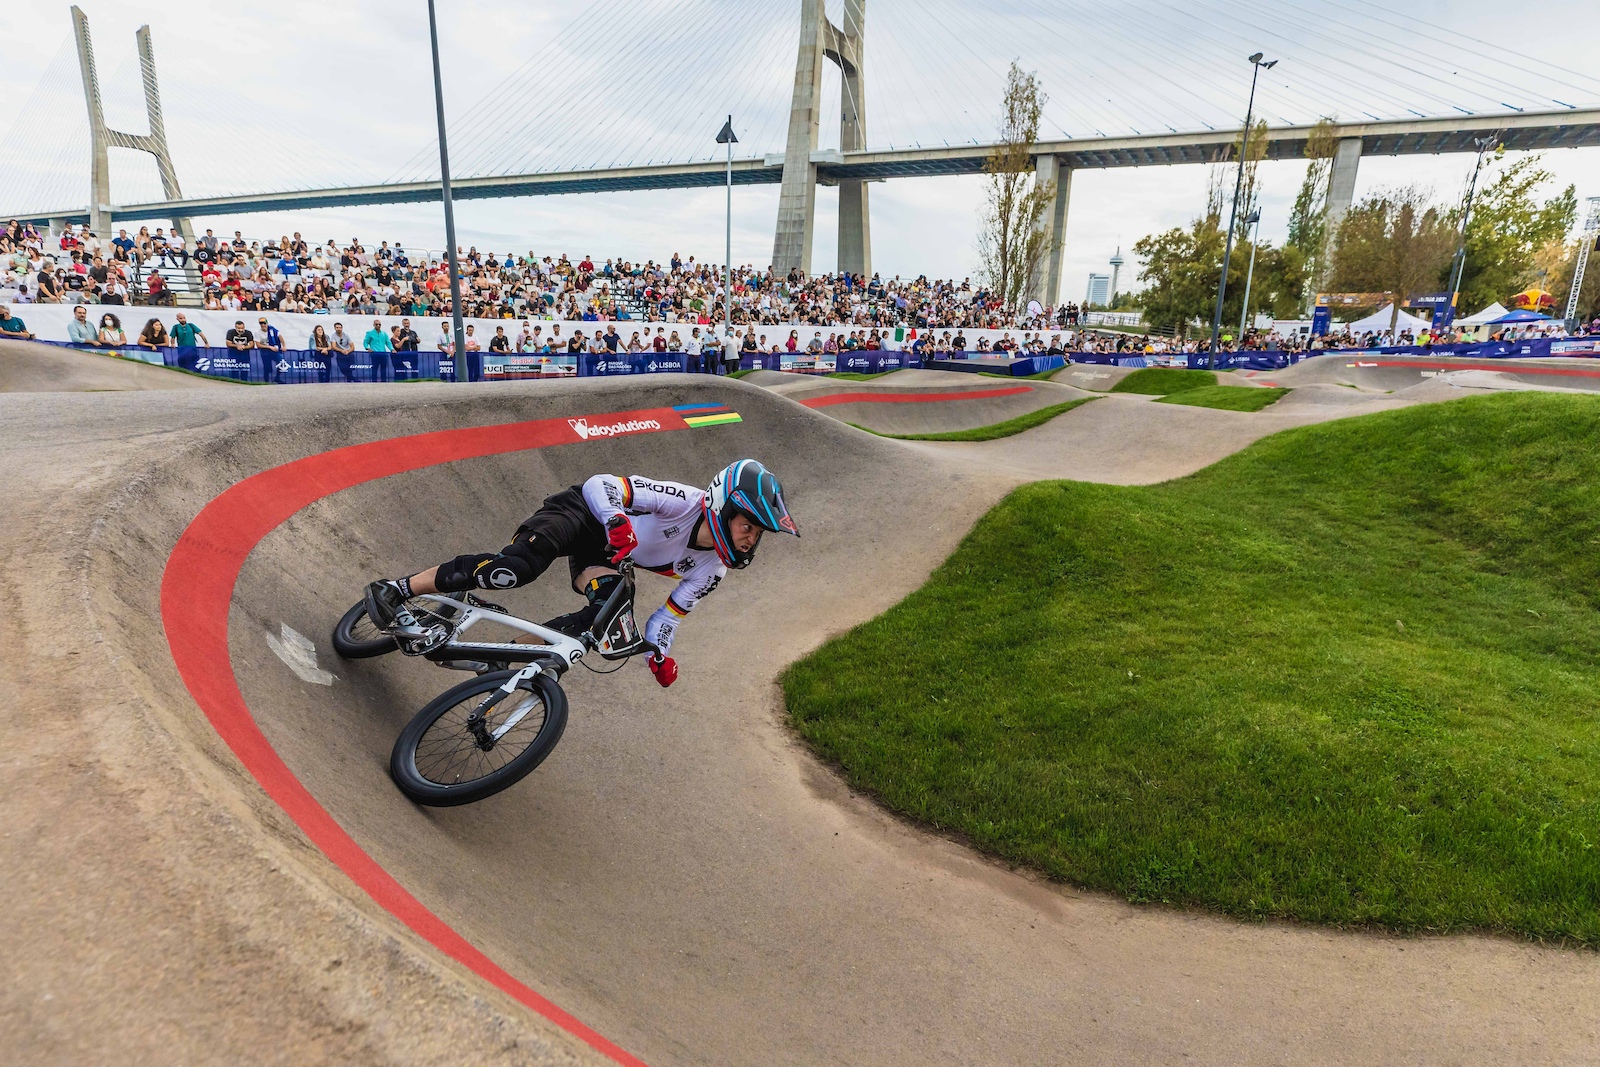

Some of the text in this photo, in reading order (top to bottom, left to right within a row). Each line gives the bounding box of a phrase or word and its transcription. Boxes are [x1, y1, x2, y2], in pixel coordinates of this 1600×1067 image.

[568, 419, 660, 439] Velosolutions
[634, 479, 686, 501] ŠKODA
[611, 630, 621, 643] 2
